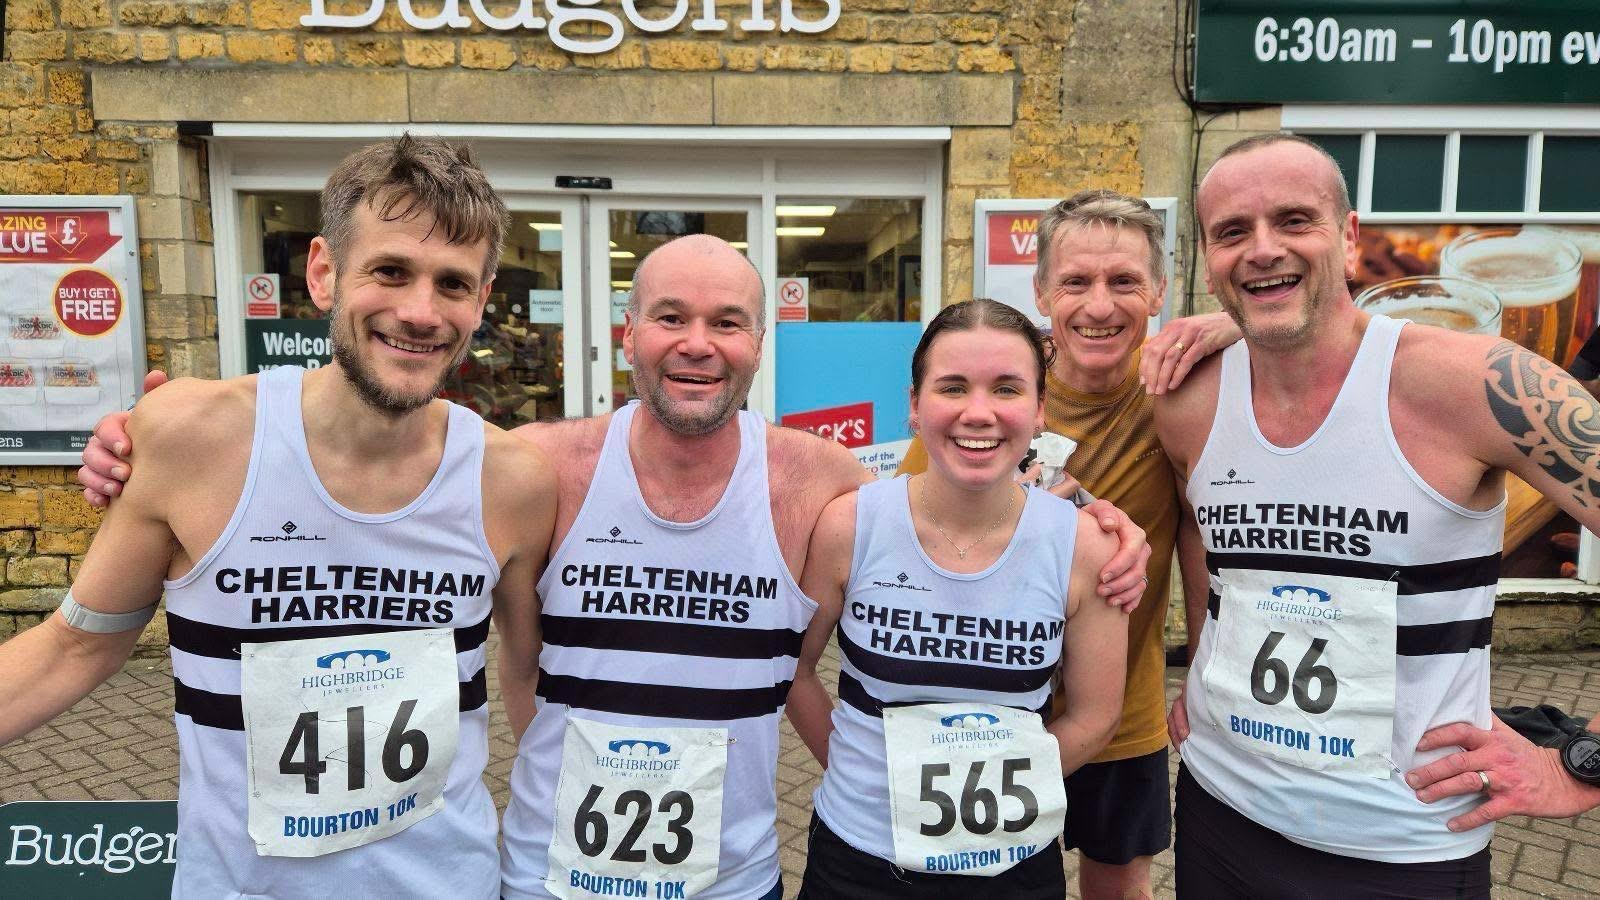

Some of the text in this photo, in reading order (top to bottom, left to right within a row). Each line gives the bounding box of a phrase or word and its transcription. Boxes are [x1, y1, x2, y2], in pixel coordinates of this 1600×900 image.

[1254, 16, 1397, 63] 6:30am
[1447, 18, 1552, 73] 10pm
[59, 287, 117, 299] BUY 1 GET 1
[61, 299, 117, 320] FREE
[808, 418, 866, 443] CK'S
[869, 453, 878, 463] of
[880, 451, 895, 461] the
[1197, 503, 1409, 534] CHELTENHAM
[249, 534, 327, 542] RONHILL
[585, 537, 644, 545] RONHILL
[1211, 528, 1372, 557] HARRIERS
[215, 565, 486, 598] CHELTENHAM
[561, 565, 778, 600] CHELTENHAM
[872, 581, 933, 592] RONHILL
[251, 594, 454, 624] HARRIERS
[581, 590, 751, 624] HARRIERS
[851, 601, 1065, 642] CHELTENHAM
[1257, 600, 1343, 621] HIGHBRIDGE
[870, 628, 1045, 666] HARRIERS
[302, 667, 405, 689] HIGHBRIDGE
[1250, 630, 1338, 715] 66
[279, 699, 430, 795] 416
[932, 729, 1014, 744] HIGHBRIDGE
[1230, 714, 1356, 759] BOURTON 10K
[596, 756, 681, 771] HIGHBRIDGE
[919, 757, 1039, 837] 565
[284, 792, 418, 838] BOURTON 10K
[574, 783, 694, 865] 623
[926, 848, 1000, 872] BOURTON
[570, 869, 687, 900] BOURTON 10K
